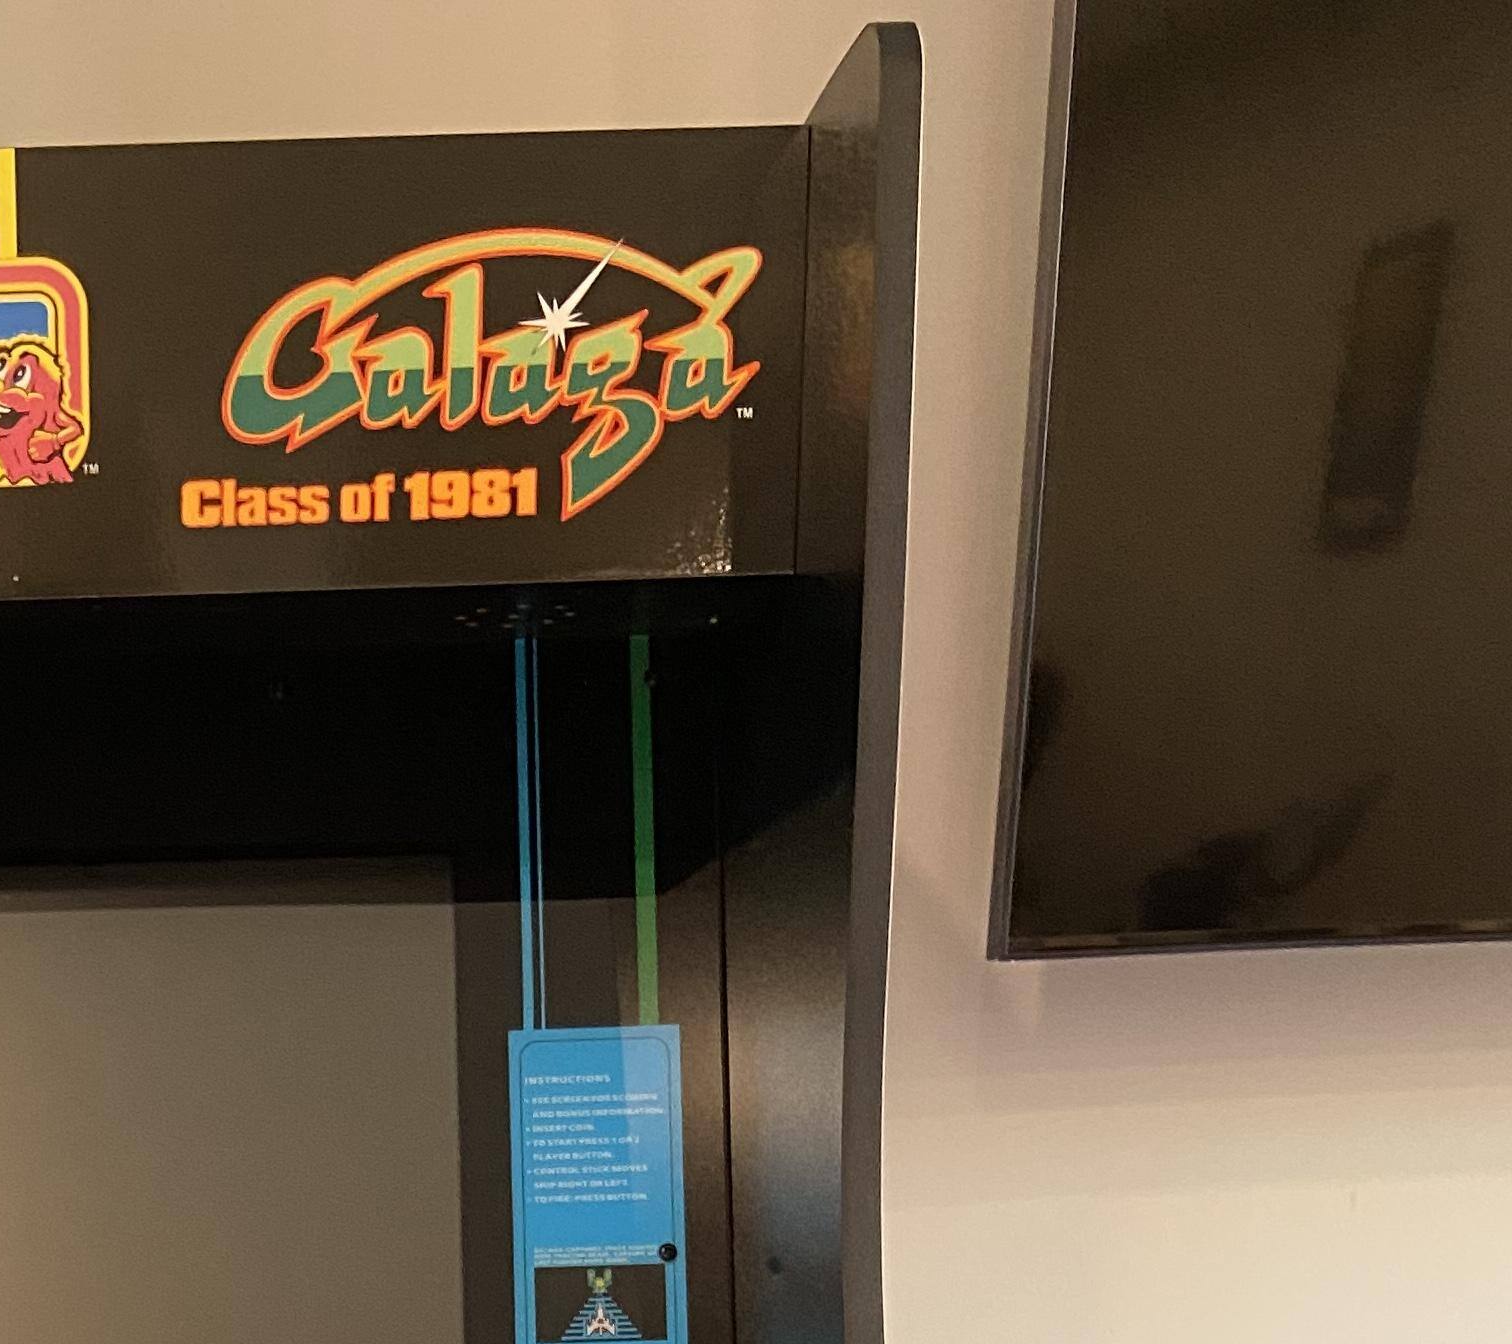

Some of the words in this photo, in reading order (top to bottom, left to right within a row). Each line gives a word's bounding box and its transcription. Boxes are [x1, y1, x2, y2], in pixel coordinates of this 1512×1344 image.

[222, 227, 763, 522] Galaga
[736, 407, 753, 418] TM
[180, 477, 330, 529] Class
[340, 473, 396, 523] of
[404, 468, 538, 521] 1981
